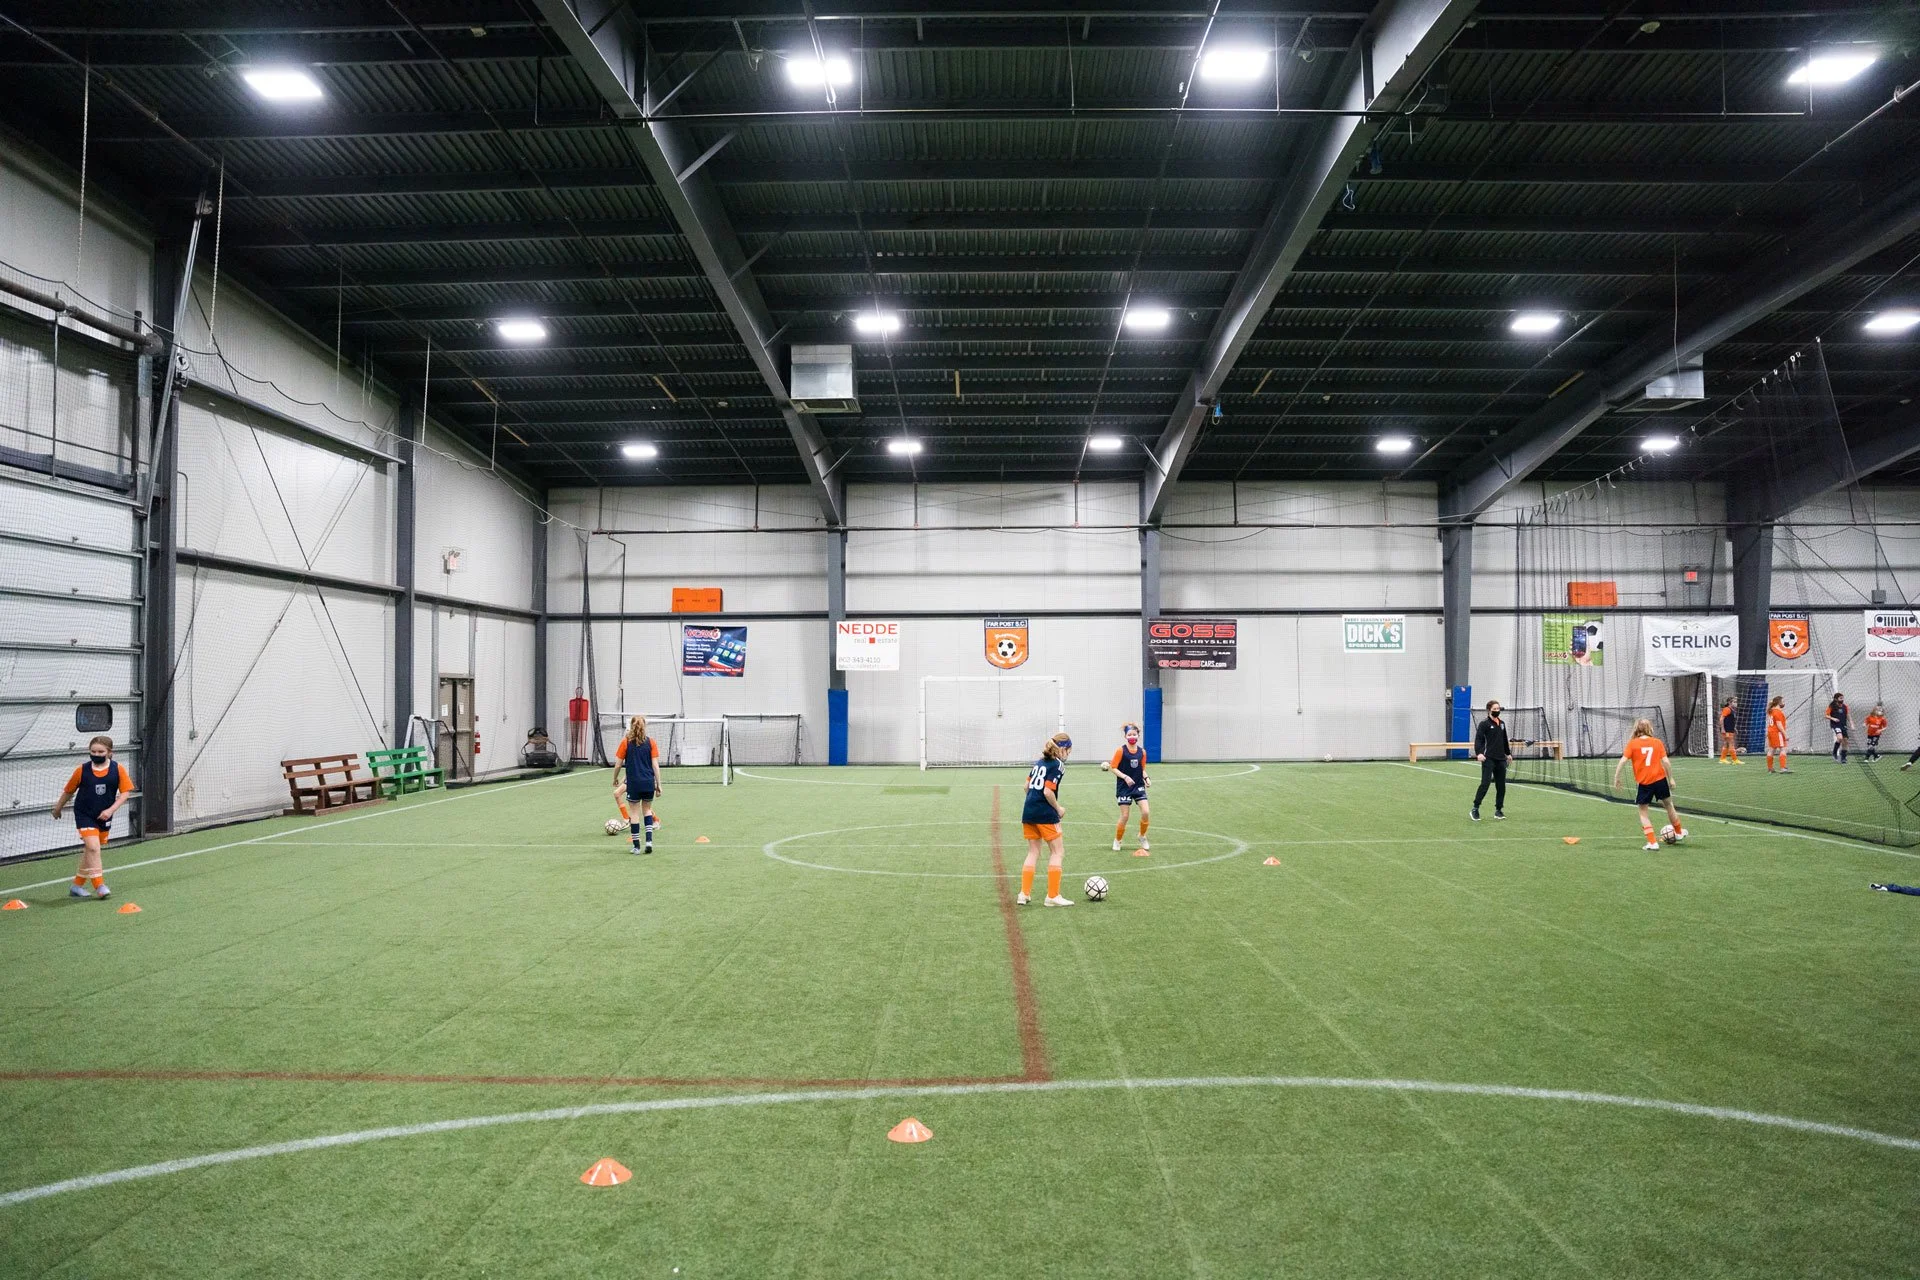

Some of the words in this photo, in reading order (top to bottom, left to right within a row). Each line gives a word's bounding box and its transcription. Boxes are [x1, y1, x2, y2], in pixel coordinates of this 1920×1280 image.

[839, 623, 898, 634] NEDDE
[1150, 624, 1235, 637] GOSS
[1347, 624, 1400, 642] DICK'S
[1651, 635, 1731, 648] STERLING
[1641, 747, 1653, 766] 7
[1028, 765, 1047, 790] 28
